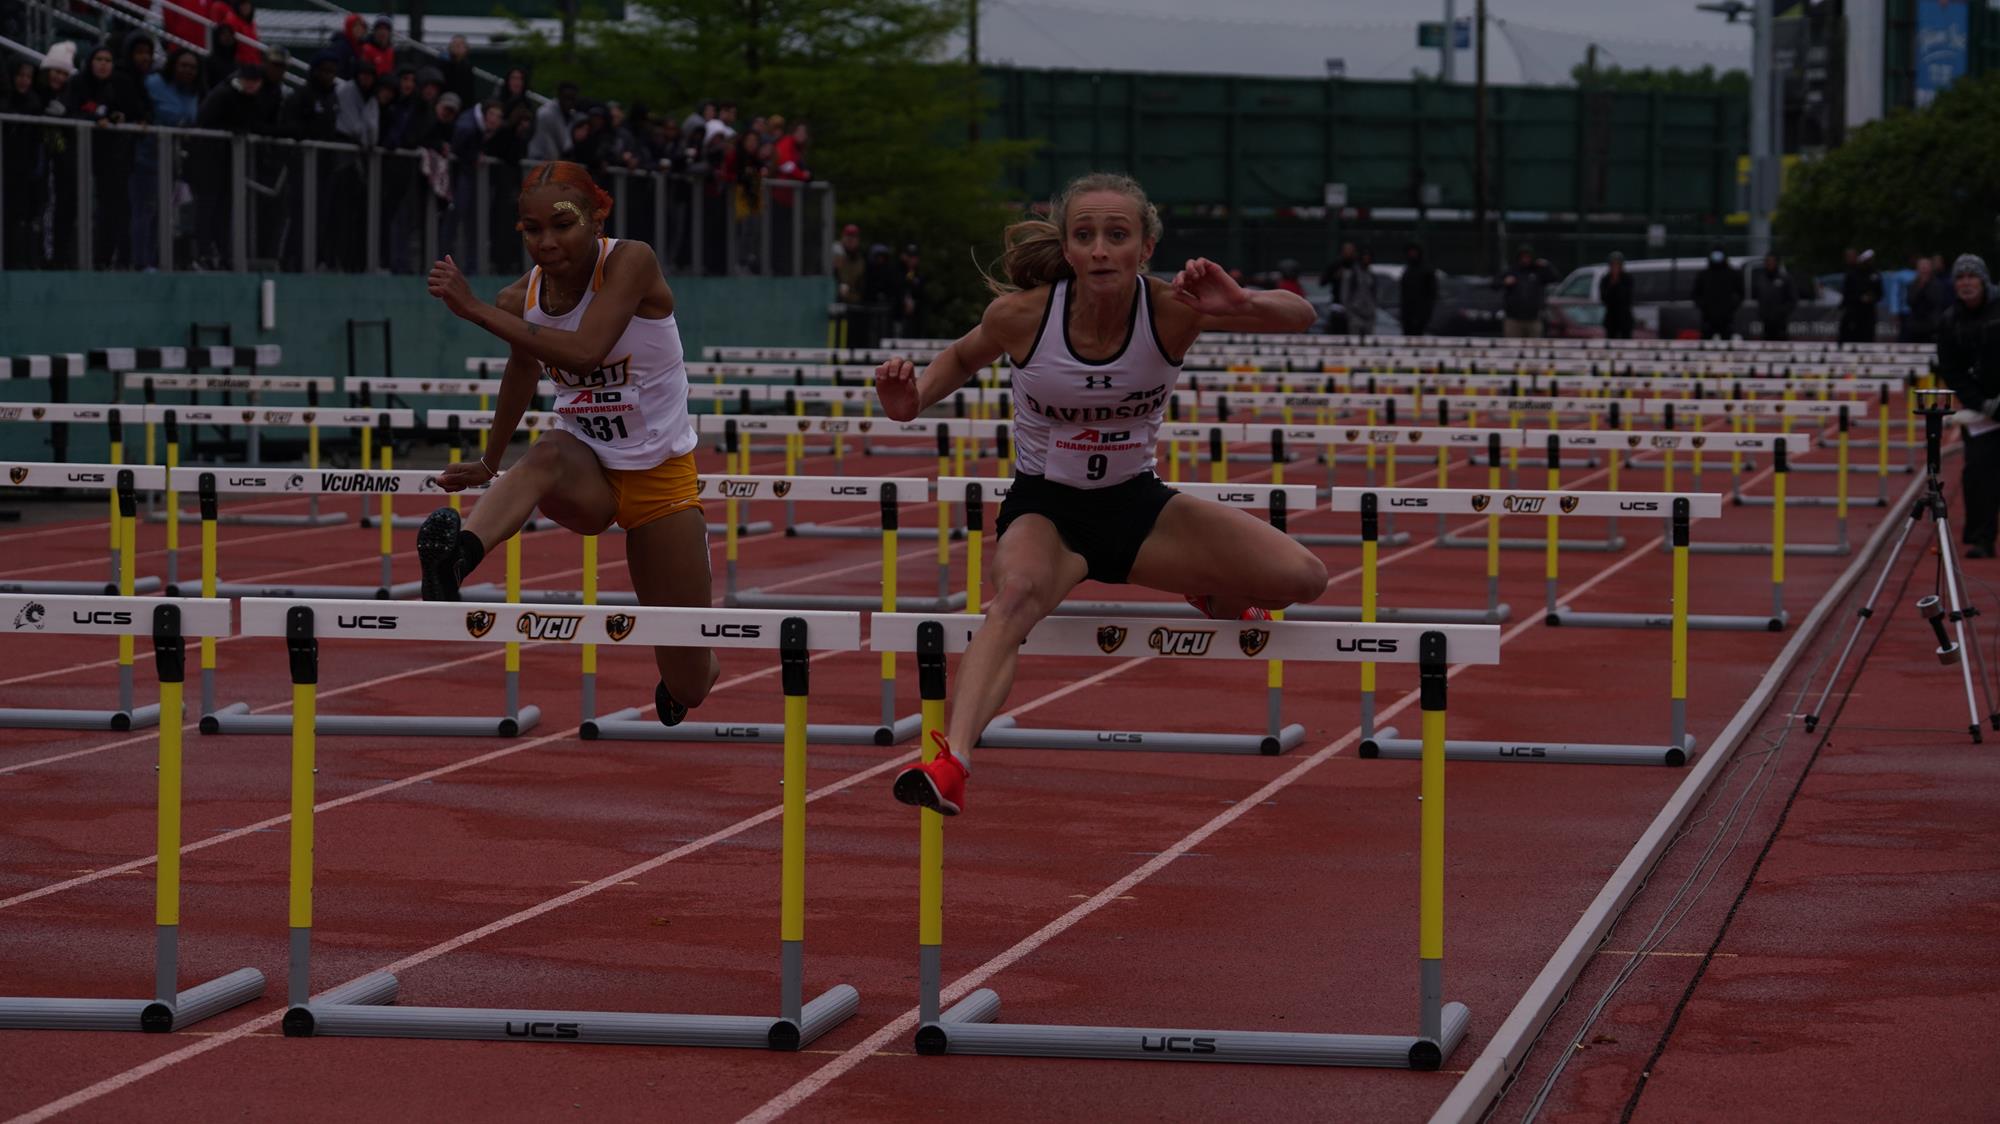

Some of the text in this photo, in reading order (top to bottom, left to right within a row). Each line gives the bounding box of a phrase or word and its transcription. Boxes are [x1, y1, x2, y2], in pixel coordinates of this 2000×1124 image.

[570, 390, 622, 404] A10
[558, 404, 634, 415] CHAMPIONSHIPS
[1026, 392, 1168, 423] DAVIDSON
[576, 415, 629, 442] 331
[1071, 428, 1130, 443] A10
[1055, 440, 1142, 452] CHAMPIONSHIPS
[1086, 454, 1108, 481] 9
[68, 473, 105, 482] UCS
[229, 478, 266, 487] UCS
[719, 481, 758, 498] VCU
[831, 486, 868, 495] UCS
[1217, 492, 1254, 502] UCS
[1391, 498, 1428, 507] UCS
[1504, 495, 1546, 513] VCU
[1620, 501, 1658, 511] UCS
[73, 611, 132, 625] UCS
[338, 615, 398, 629] UCS
[518, 611, 584, 640] VCU
[701, 623, 760, 638] UCS
[1149, 628, 1217, 656] VCU
[1337, 638, 1398, 653] UCS
[715, 727, 759, 738] UCS
[1097, 733, 1143, 743] UCS
[1499, 746, 1546, 757] UCS
[506, 1022, 580, 1039] UCS
[1142, 1036, 1216, 1053] UCS
